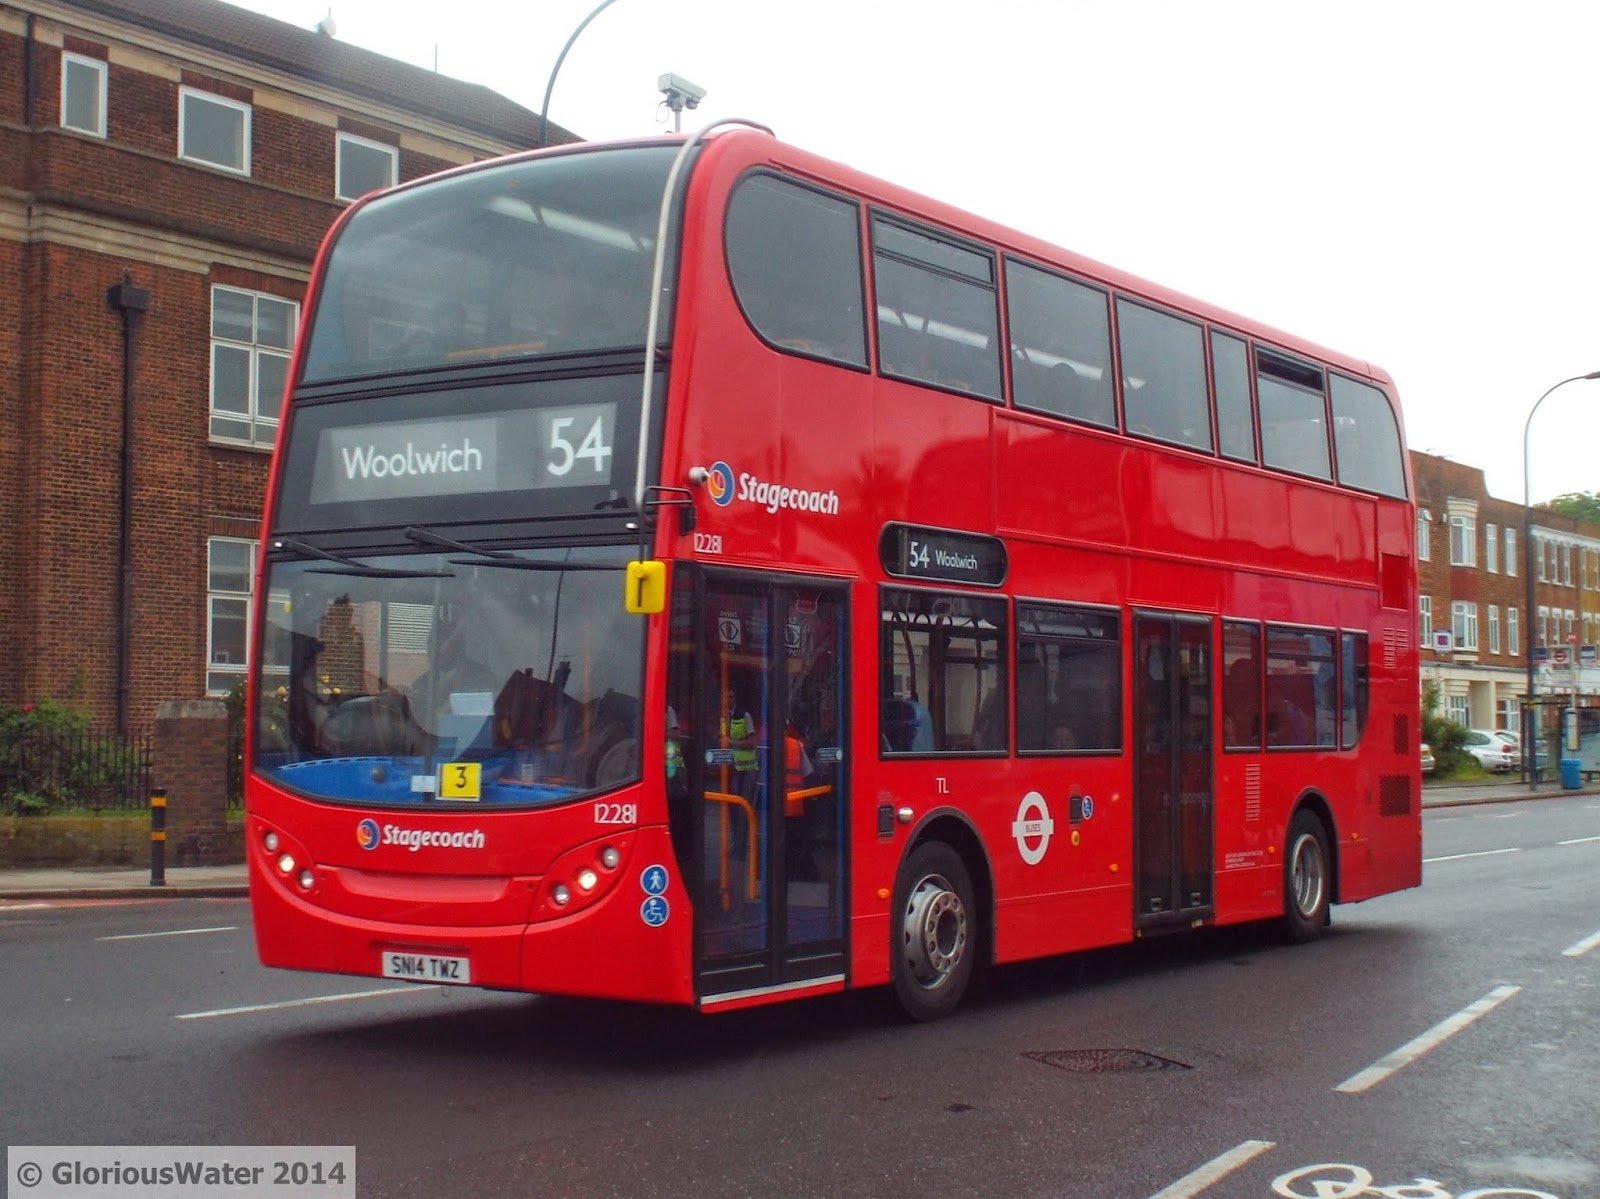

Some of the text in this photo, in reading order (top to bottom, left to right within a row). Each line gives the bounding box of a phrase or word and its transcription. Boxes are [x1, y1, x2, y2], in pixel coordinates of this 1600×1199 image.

[342, 415, 612, 479] Woolwich 54
[737, 472, 839, 515] Stagecoach
[693, 532, 722, 554] 12281
[909, 541, 978, 570] 54 Woolwich
[455, 766, 467, 788] 3
[936, 777, 949, 794] TL
[594, 803, 637, 824] 12281
[382, 824, 485, 852] Stagecoach
[1025, 823, 1041, 833] BUSES
[392, 956, 459, 978] SN14 TWZ
